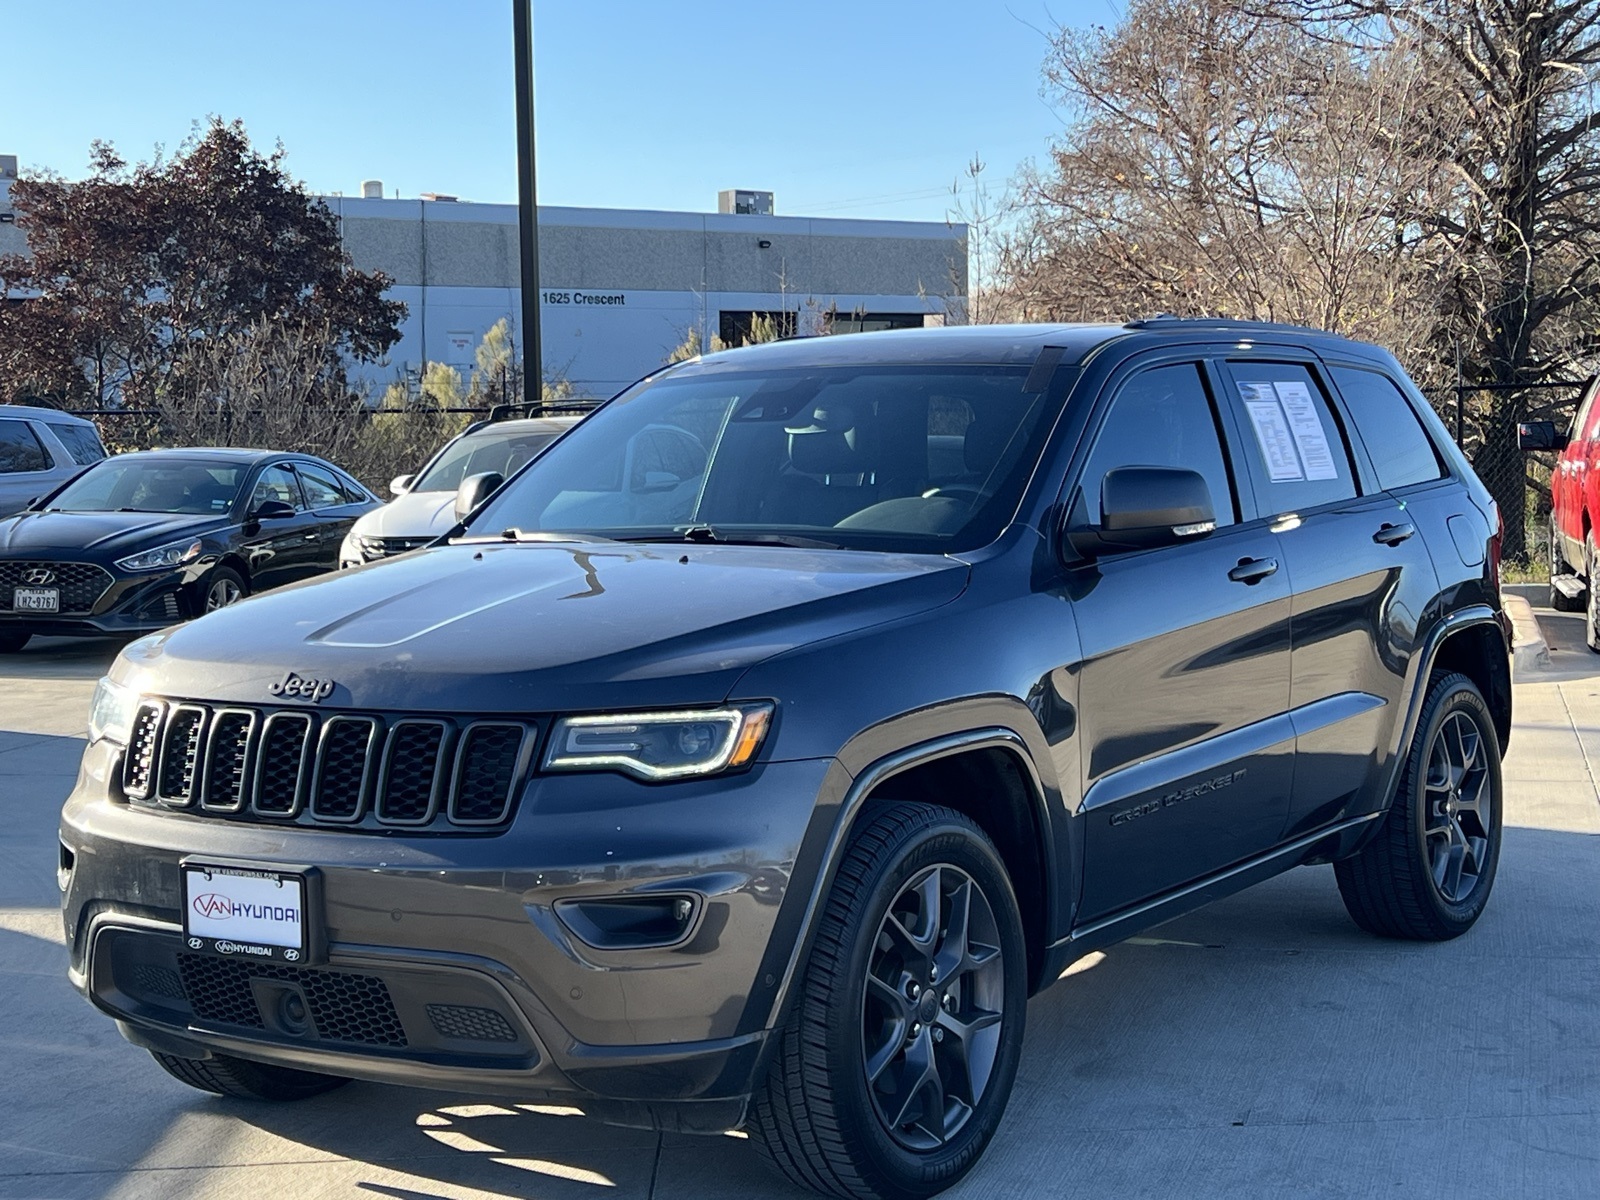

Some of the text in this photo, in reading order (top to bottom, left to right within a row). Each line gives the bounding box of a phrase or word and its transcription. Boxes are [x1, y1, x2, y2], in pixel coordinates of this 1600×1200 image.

[543, 292, 625, 305] 1625 Crescent
[268, 672, 334, 703] Jeep
[1109, 774, 1233, 826] GRAND CHEROKEE
